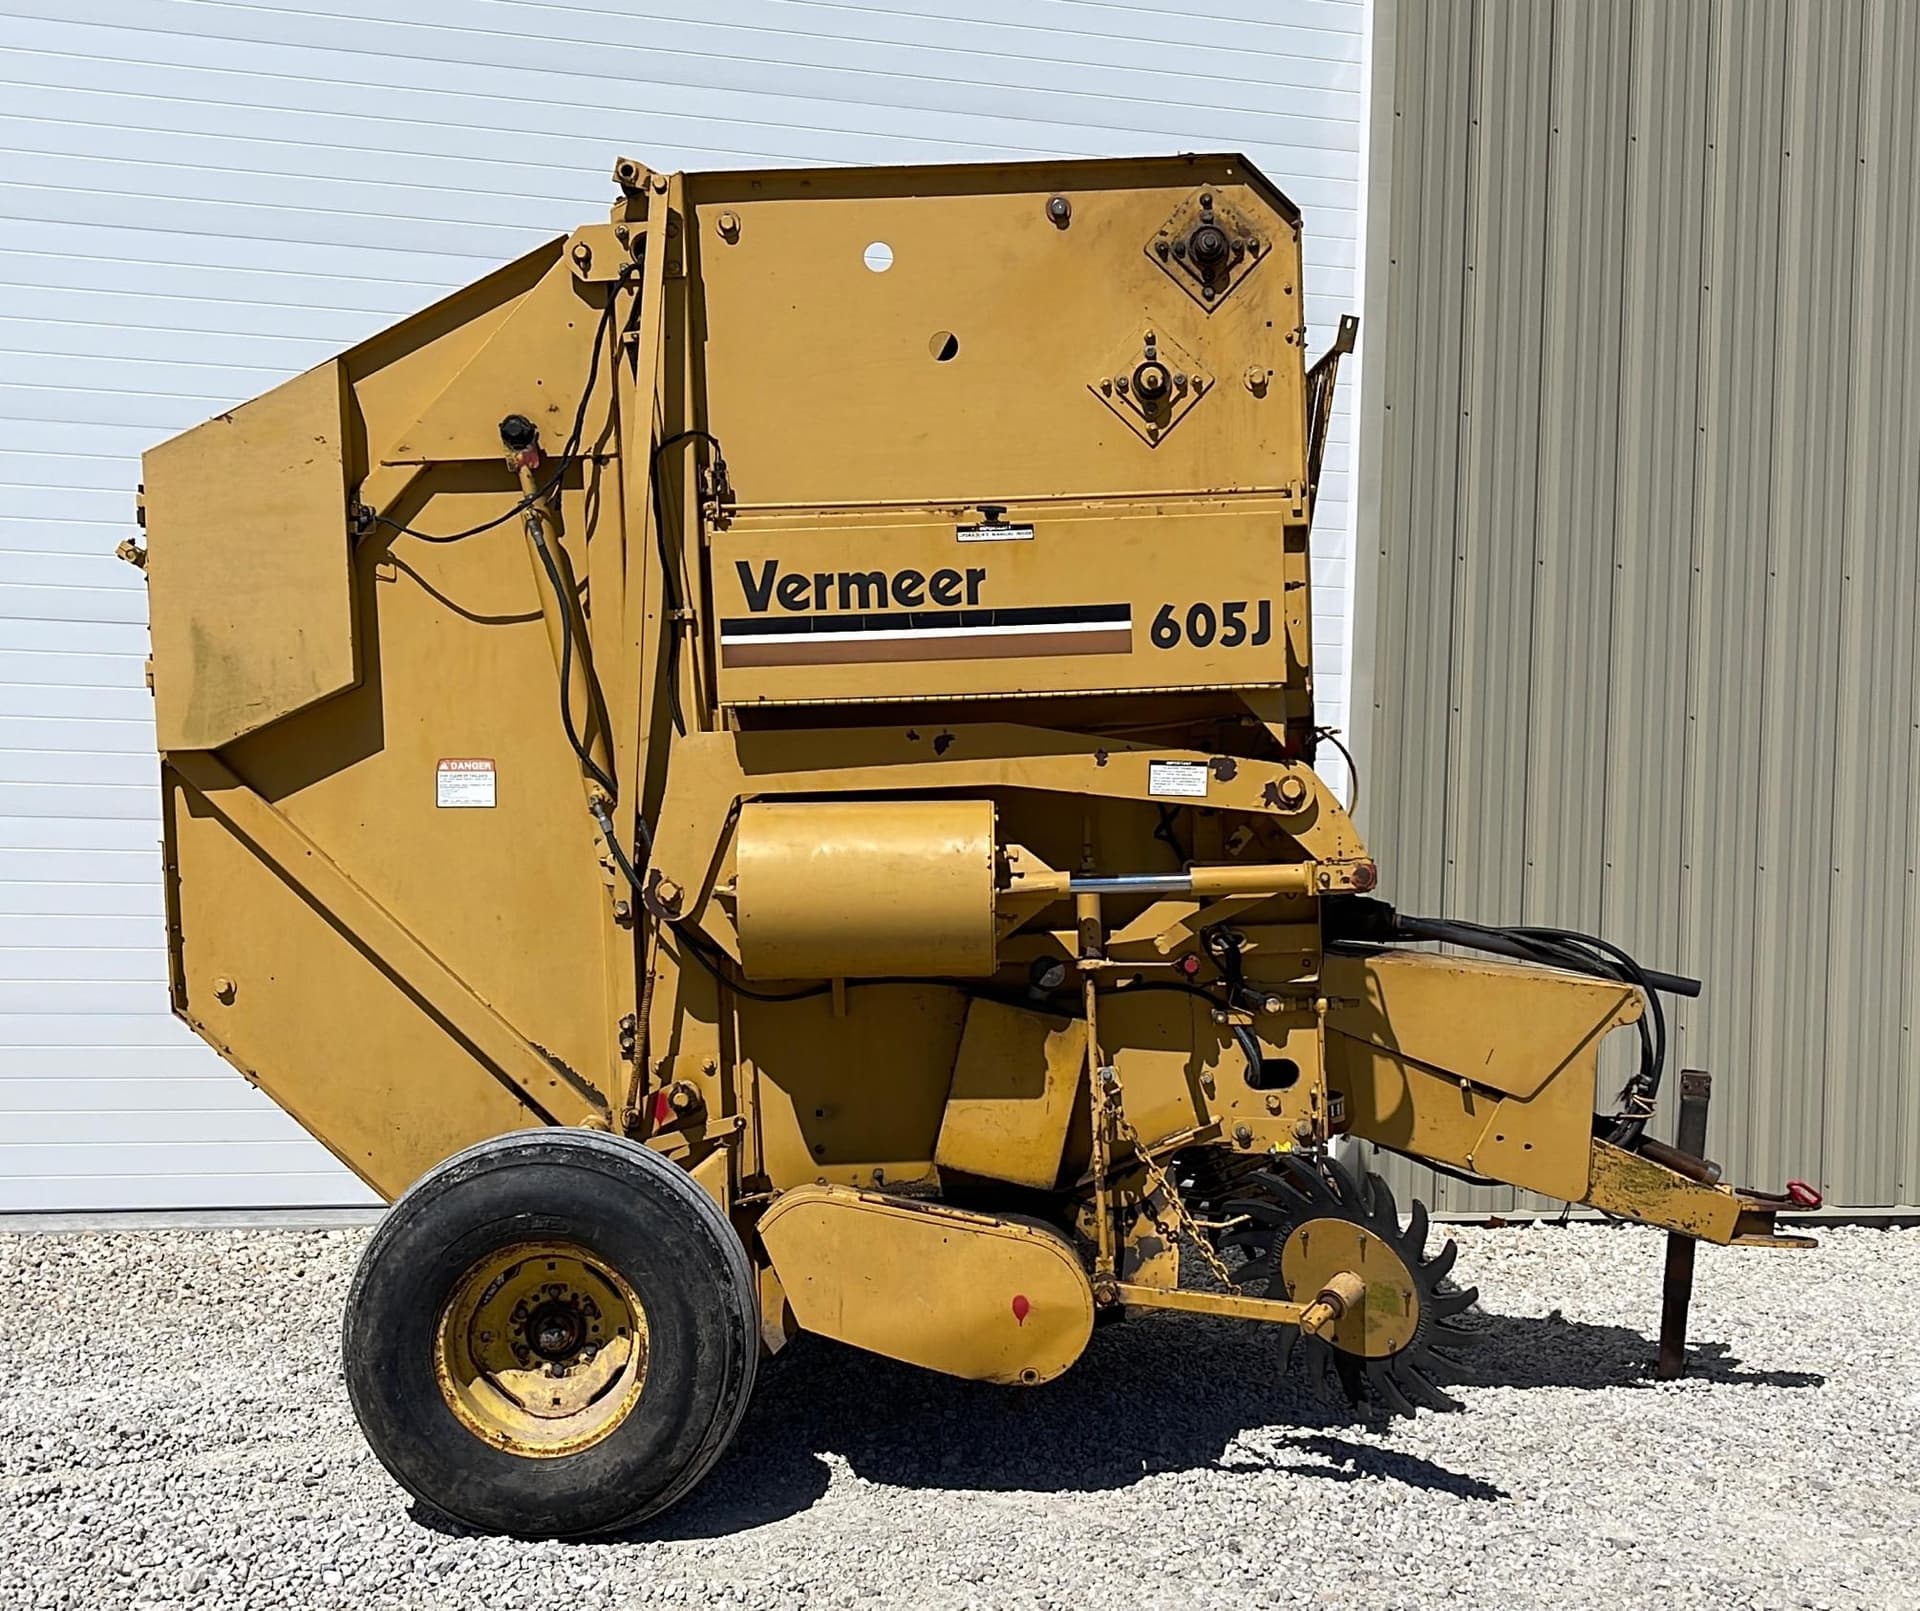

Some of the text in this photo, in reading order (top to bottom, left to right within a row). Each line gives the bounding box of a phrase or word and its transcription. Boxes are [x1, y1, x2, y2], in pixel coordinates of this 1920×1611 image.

[735, 559, 986, 612] Vermeer
[1150, 600, 1271, 649] 605J
[450, 761, 492, 770] DANGER
